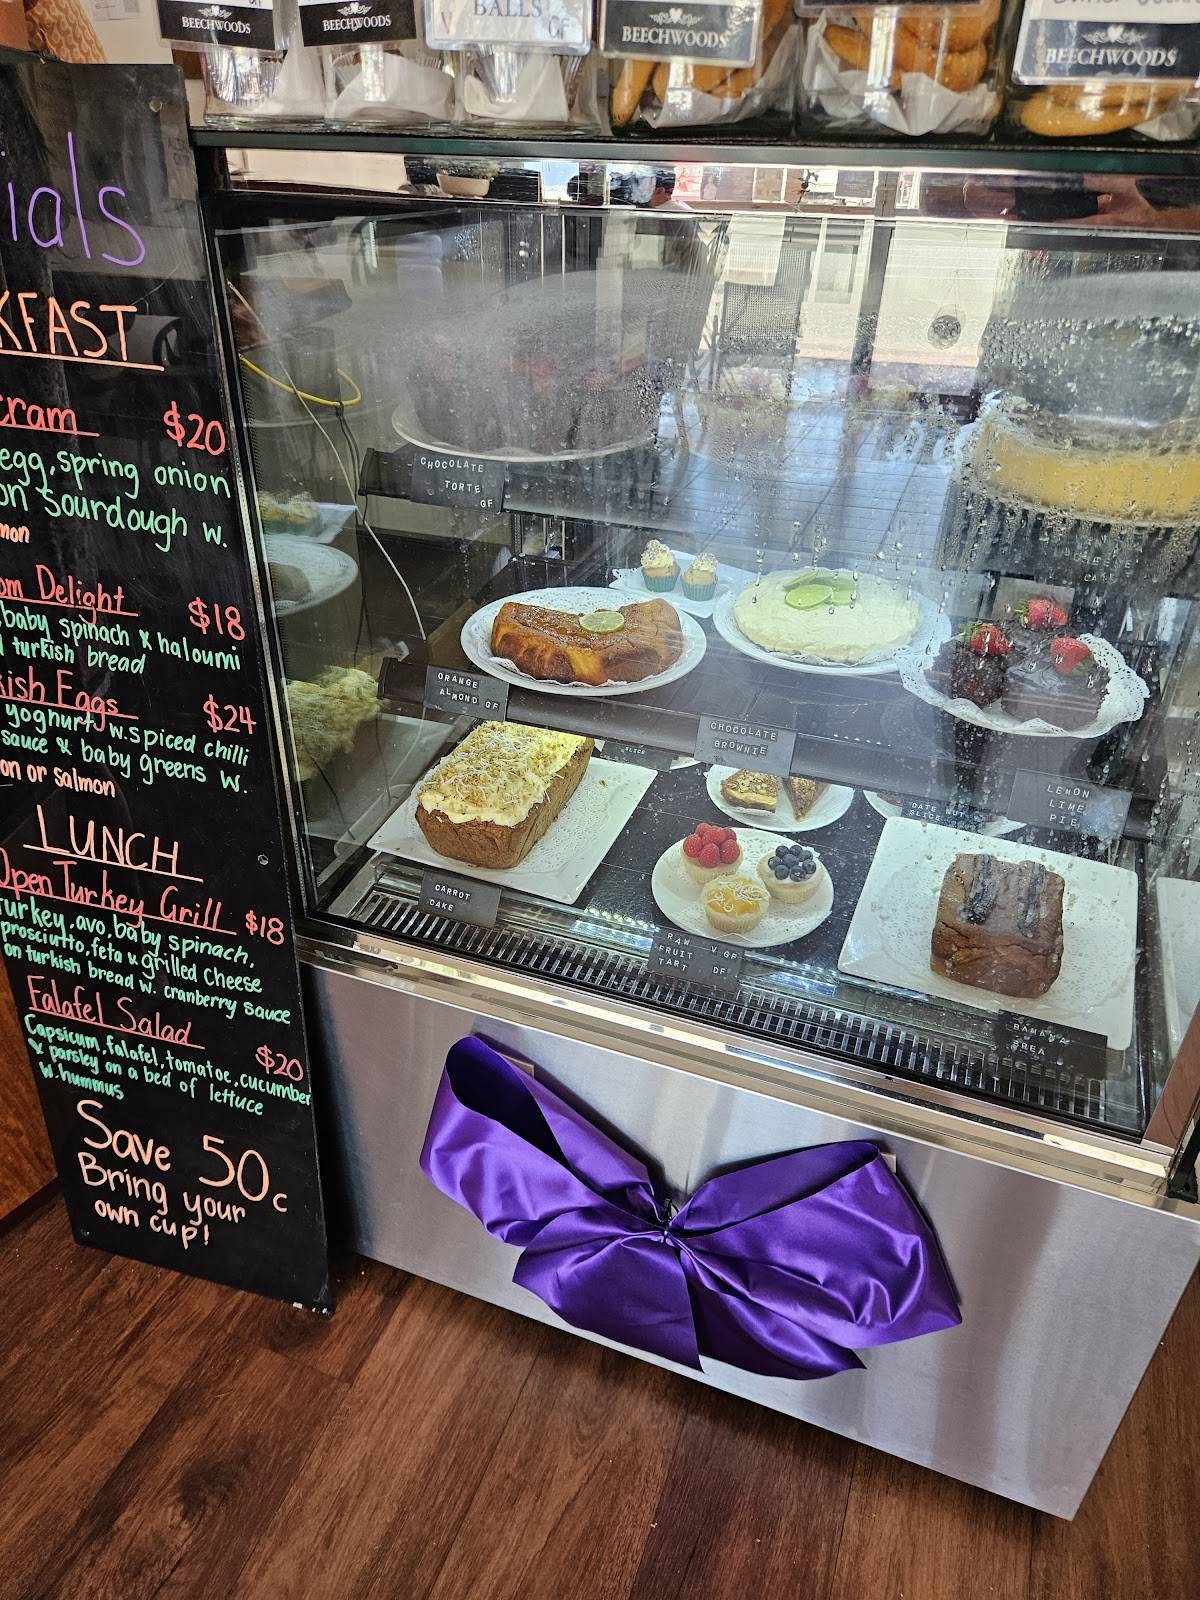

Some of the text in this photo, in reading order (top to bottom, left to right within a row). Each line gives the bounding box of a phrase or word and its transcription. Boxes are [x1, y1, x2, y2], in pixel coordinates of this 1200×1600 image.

[473, 0, 542, 17] BALLS
[181, 16, 251, 34] BEECHWOODS
[323, 15, 392, 32] BEECHWOODS
[621, 26, 729, 48] BEECHWOODS
[1043, 47, 1179, 67] BEECHWOODS
[163, 400, 226, 455] $20
[420, 457, 484, 473] CHOCOLATE
[154, 461, 231, 498] onion
[444, 480, 481, 493] TORTE
[480, 499, 493, 508] GF
[202, 522, 227, 548] w.
[36, 564, 124, 625] Delight
[188, 597, 245, 640] $18
[0, 600, 54, 644] baby
[58, 617, 130, 647] spinach
[157, 632, 241, 670] haloumi
[12, 636, 74, 664] turkish
[87, 645, 146, 674] bread
[437, 672, 478, 689] ORANGE
[57, 669, 119, 731] Eggs
[203, 694, 257, 734] $24
[439, 687, 499, 710] ALMOND GF
[5, 703, 94, 734] yoghurt
[204, 741, 250, 766] chilli
[710, 722, 777, 741] CHOCOLATE
[1, 730, 48, 754] sauce
[81, 738, 130, 778] baby
[140, 754, 207, 785] greens
[714, 740, 767, 755] BROWNIE
[27, 764, 47, 782] or
[1047, 785, 1090, 798] LEMON
[909, 809, 941, 821] SLICE
[911, 802, 937, 812] DATE
[1049, 799, 1084, 813] LIME
[1050, 813, 1077, 826] PIE
[37, 804, 179, 874] LUNCH
[53, 861, 144, 928] Turkey
[160, 885, 221, 931] Grill
[245, 910, 285, 945] $18
[434, 884, 471, 900] CARROT
[429, 899, 454, 912] CAKE
[658, 945, 693, 960] FRUIT
[667, 932, 691, 946] RAW
[723, 951, 738, 960] GF
[142, 951, 197, 980] grilled
[658, 958, 726, 975] TART DF
[4, 943, 22, 958] on
[25, 944, 81, 975] turkish
[88, 961, 134, 990] bread
[164, 985, 237, 1020] cranberry
[244, 1002, 291, 1025] sauce
[26, 975, 304, 1081] Falafel Salad $20
[49, 1045, 99, 1075] parsley
[105, 1062, 122, 1075] on
[128, 1067, 138, 1080] a
[143, 1066, 172, 1087] bed
[180, 1077, 198, 1098] of
[209, 1083, 264, 1116] lettuce
[240, 1073, 311, 1106] cucumber
[77, 1100, 171, 1171] Save
[78, 1152, 246, 1226] Bring your
[94, 1199, 210, 1250] own cup!
